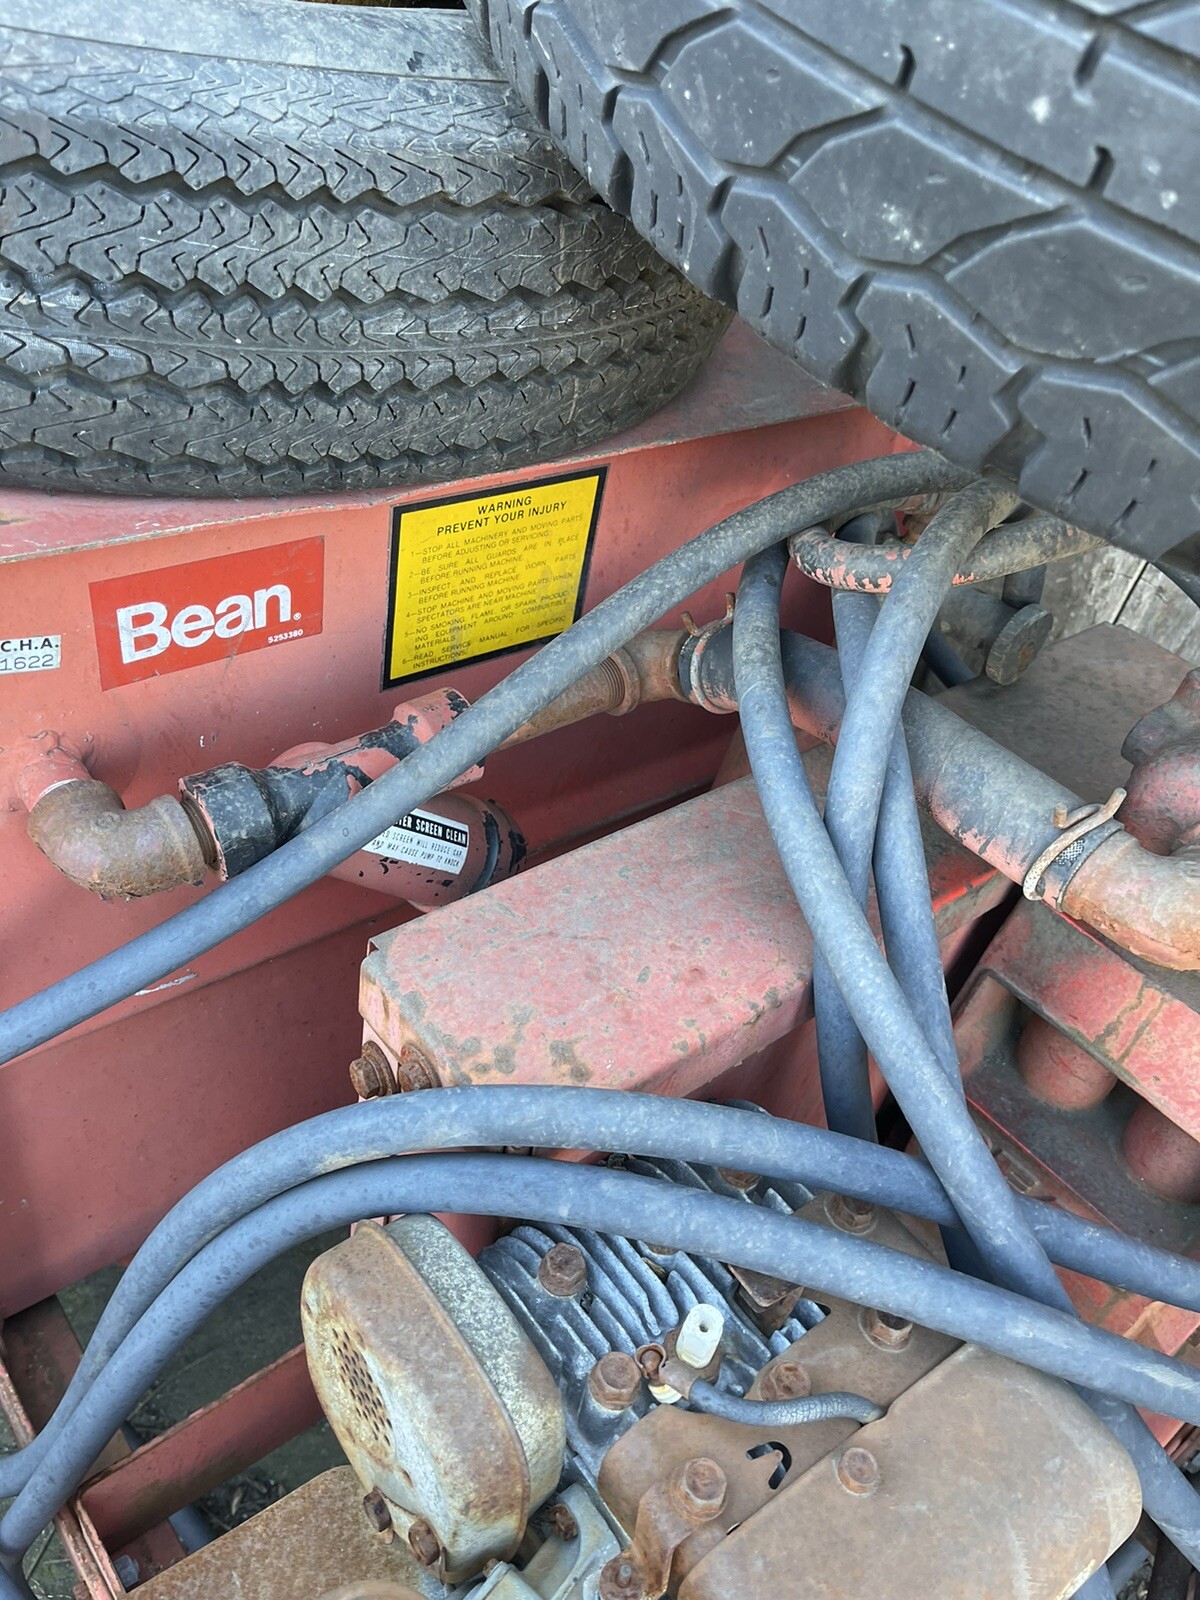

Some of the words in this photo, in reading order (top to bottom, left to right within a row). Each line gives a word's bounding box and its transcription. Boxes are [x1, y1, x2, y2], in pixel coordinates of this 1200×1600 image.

[478, 496, 532, 514] WARNING
[437, 516, 489, 535] PREVENT
[494, 509, 524, 524] YOUR
[528, 501, 566, 517] INJURY
[446, 541, 459, 549] ALL
[464, 530, 507, 546] MACHINERY
[511, 526, 527, 535] AND
[530, 520, 557, 531] MOVING
[561, 515, 582, 525] PARTS
[422, 551, 451, 563] BEFORE
[455, 542, 495, 556] ADJUSTING
[498, 539, 509, 547] OR
[438, 561, 458, 571] SURE
[465, 556, 479, 565] ALL
[486, 548, 516, 560] GUARDS
[523, 543, 537, 552] ARE
[558, 534, 579, 544] PLACE
[420, 571, 450, 584] BEFORE
[453, 563, 487, 576] RUNNING
[460, 576, 475, 585] AND
[485, 567, 516, 579] REPLACE
[525, 560, 546, 570] WORN
[555, 553, 576, 563] PARTS
[419, 591, 448, 603] BEFORE
[451, 582, 484, 596] RUNNING
[440, 595, 473, 609] MACHINE
[478, 591, 493, 600] AND
[496, 583, 524, 595] MOVING
[527, 577, 549, 588] PARTS
[552, 571, 572, 582] WHEN
[417, 606, 464, 623] SPECTATORS
[467, 602, 480, 610] ARE
[484, 596, 503, 606] NEAR
[500, 605, 510, 613] OR
[515, 598, 536, 609] SPARK
[116, 584, 292, 665] Bean
[415, 634, 428, 642] ING
[435, 621, 476, 637] EQUIPMENT
[484, 612, 513, 624] AROUND
[521, 598, 567, 615] COMBUSTIBLE
[0, 637, 59, 652] C.H.A.
[267, 629, 304, 644] 5253380
[441, 640, 471, 654] SERVICE
[479, 630, 508, 643] MANUAL
[516, 624, 529, 633] FOR
[537, 615, 565, 628] SPECIFIC
[0, 653, 54, 671] 1622
[392, 832, 413, 844] SCREEN
[416, 840, 428, 849] WILL
[431, 842, 451, 855] REDUCE
[416, 818, 443, 838] SCREEN
[445, 828, 467, 845] CLEAN
[372, 840, 384, 848] AND
[387, 842, 400, 851] MAY
[400, 846, 418, 857] CAUSE
[420, 852, 434, 860] PUMP
[435, 855, 443, 863] TO
